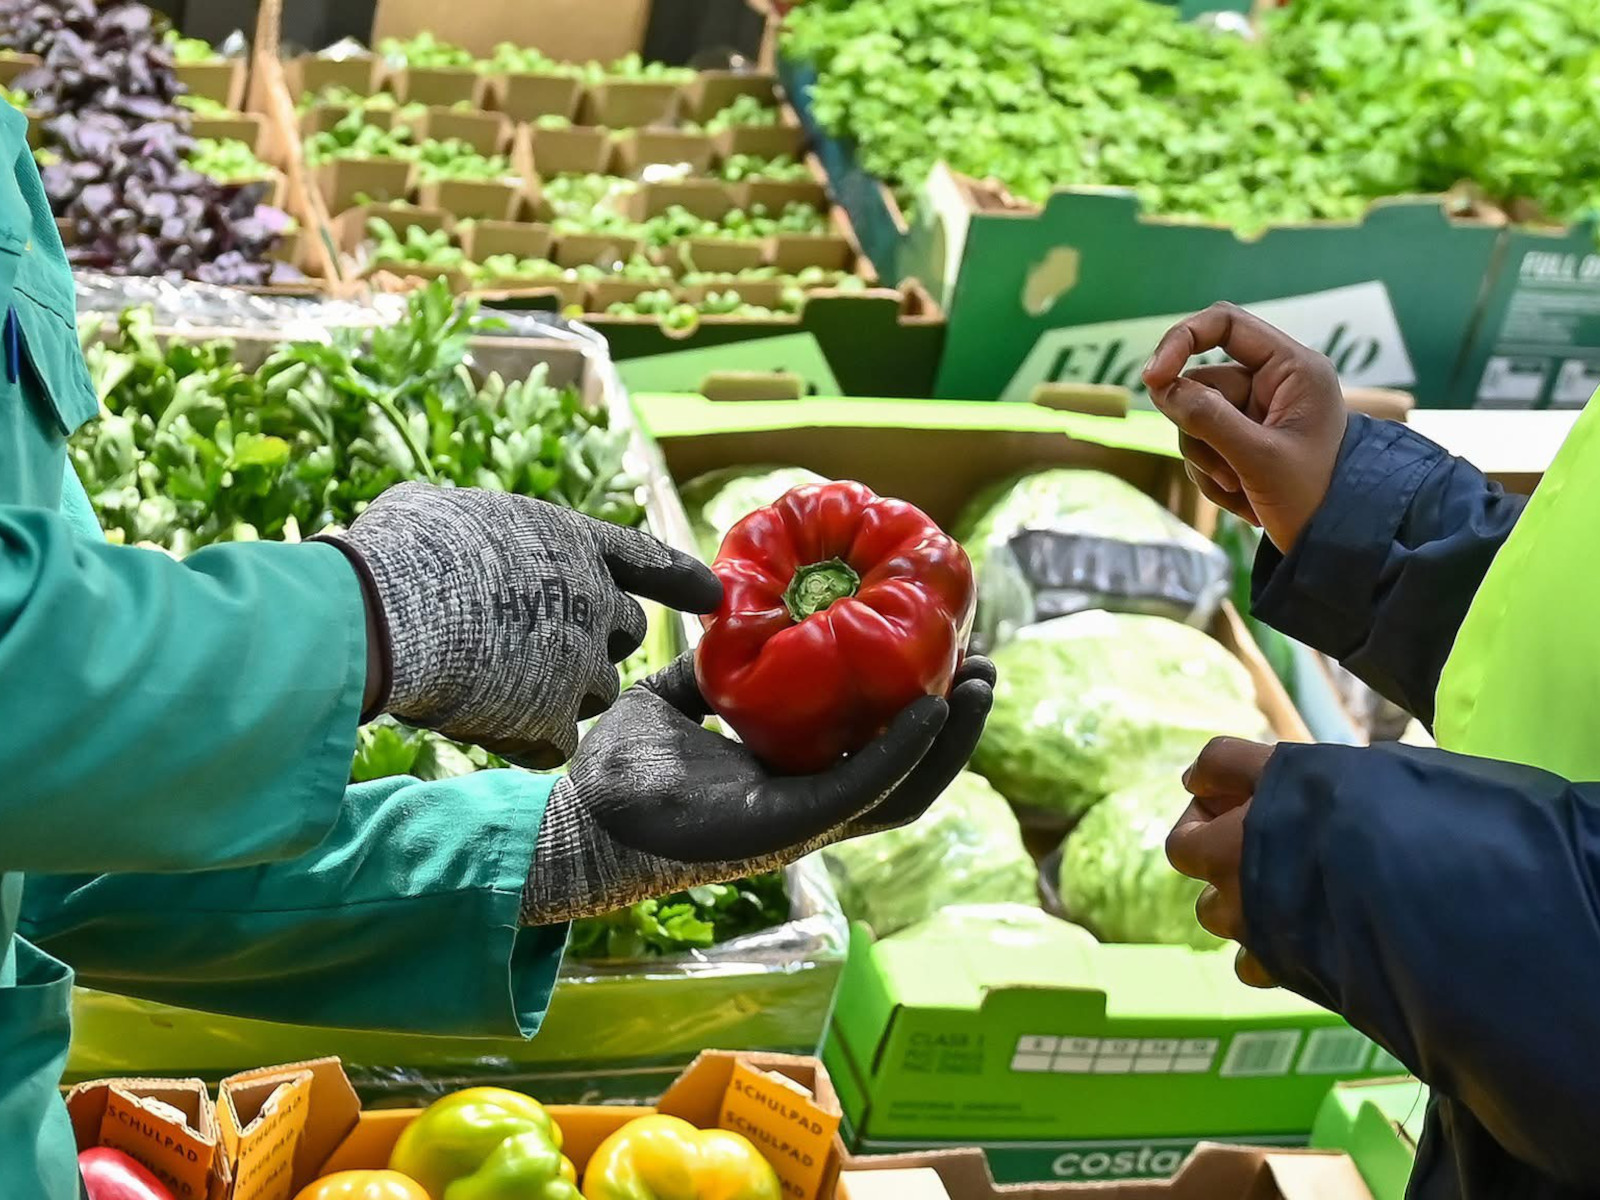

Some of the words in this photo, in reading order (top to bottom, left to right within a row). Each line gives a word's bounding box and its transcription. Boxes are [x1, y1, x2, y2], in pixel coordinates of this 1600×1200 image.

[107, 1104, 198, 1163] SCHULPAD
[734, 1079, 823, 1135] SCHULPAD
[726, 1110, 814, 1167] SCHULPAD
[1052, 1145, 1182, 1177] costa
